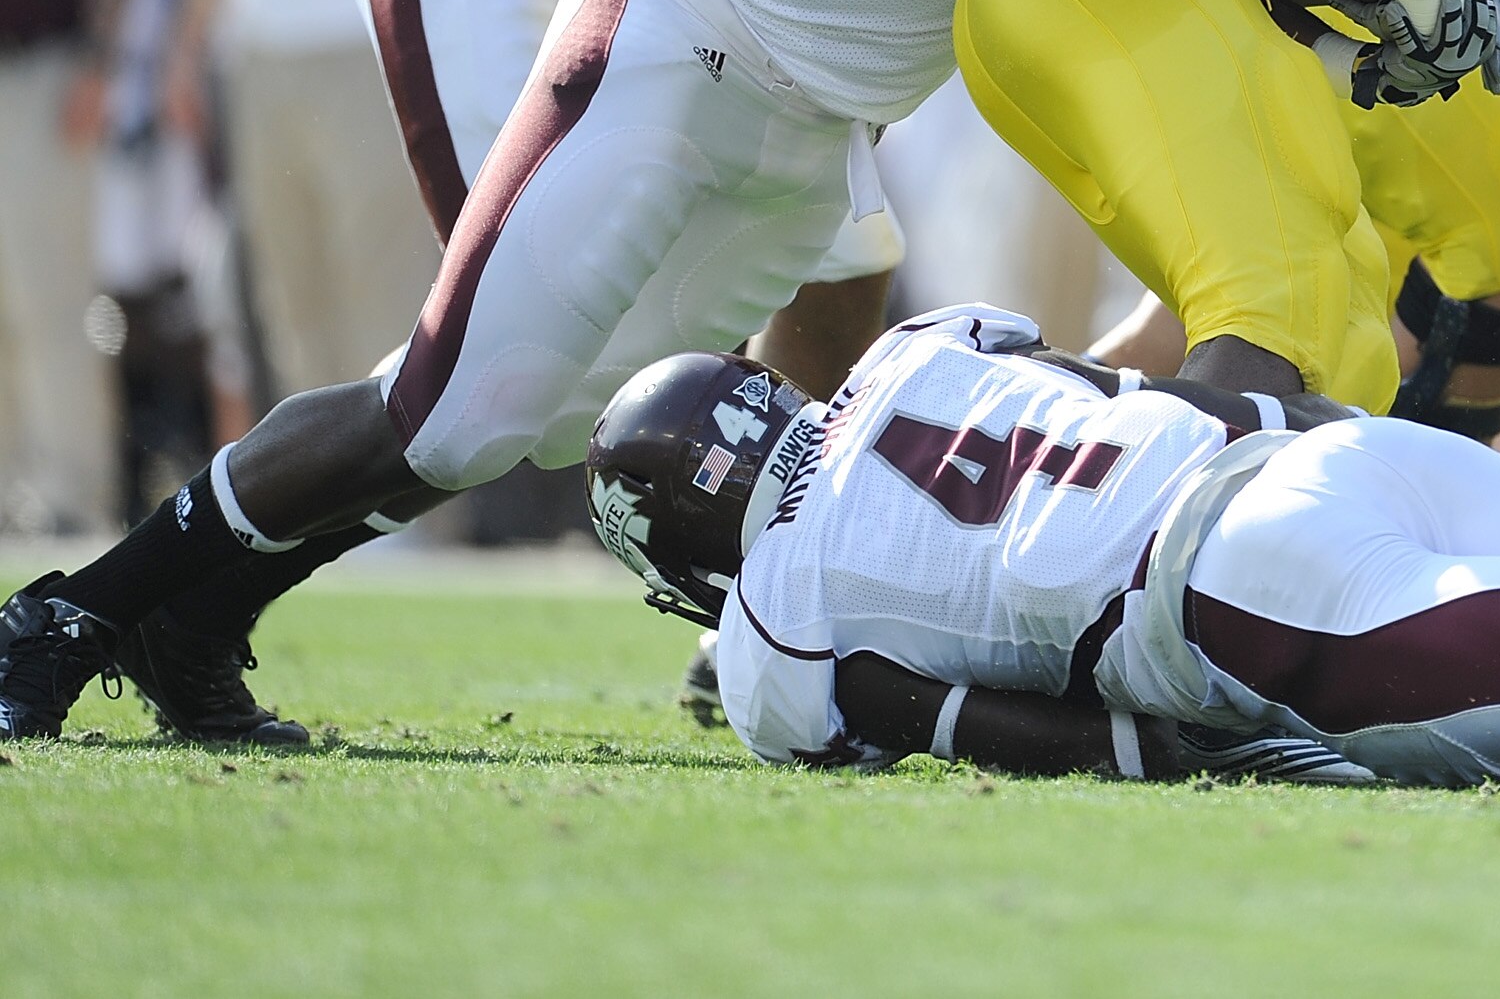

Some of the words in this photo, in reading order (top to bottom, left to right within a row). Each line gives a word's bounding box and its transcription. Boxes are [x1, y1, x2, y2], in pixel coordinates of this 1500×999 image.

[692, 45, 723, 83] adidas
[712, 400, 769, 446] 4
[768, 419, 817, 485] DAWGS
[866, 409, 1132, 531] 4
